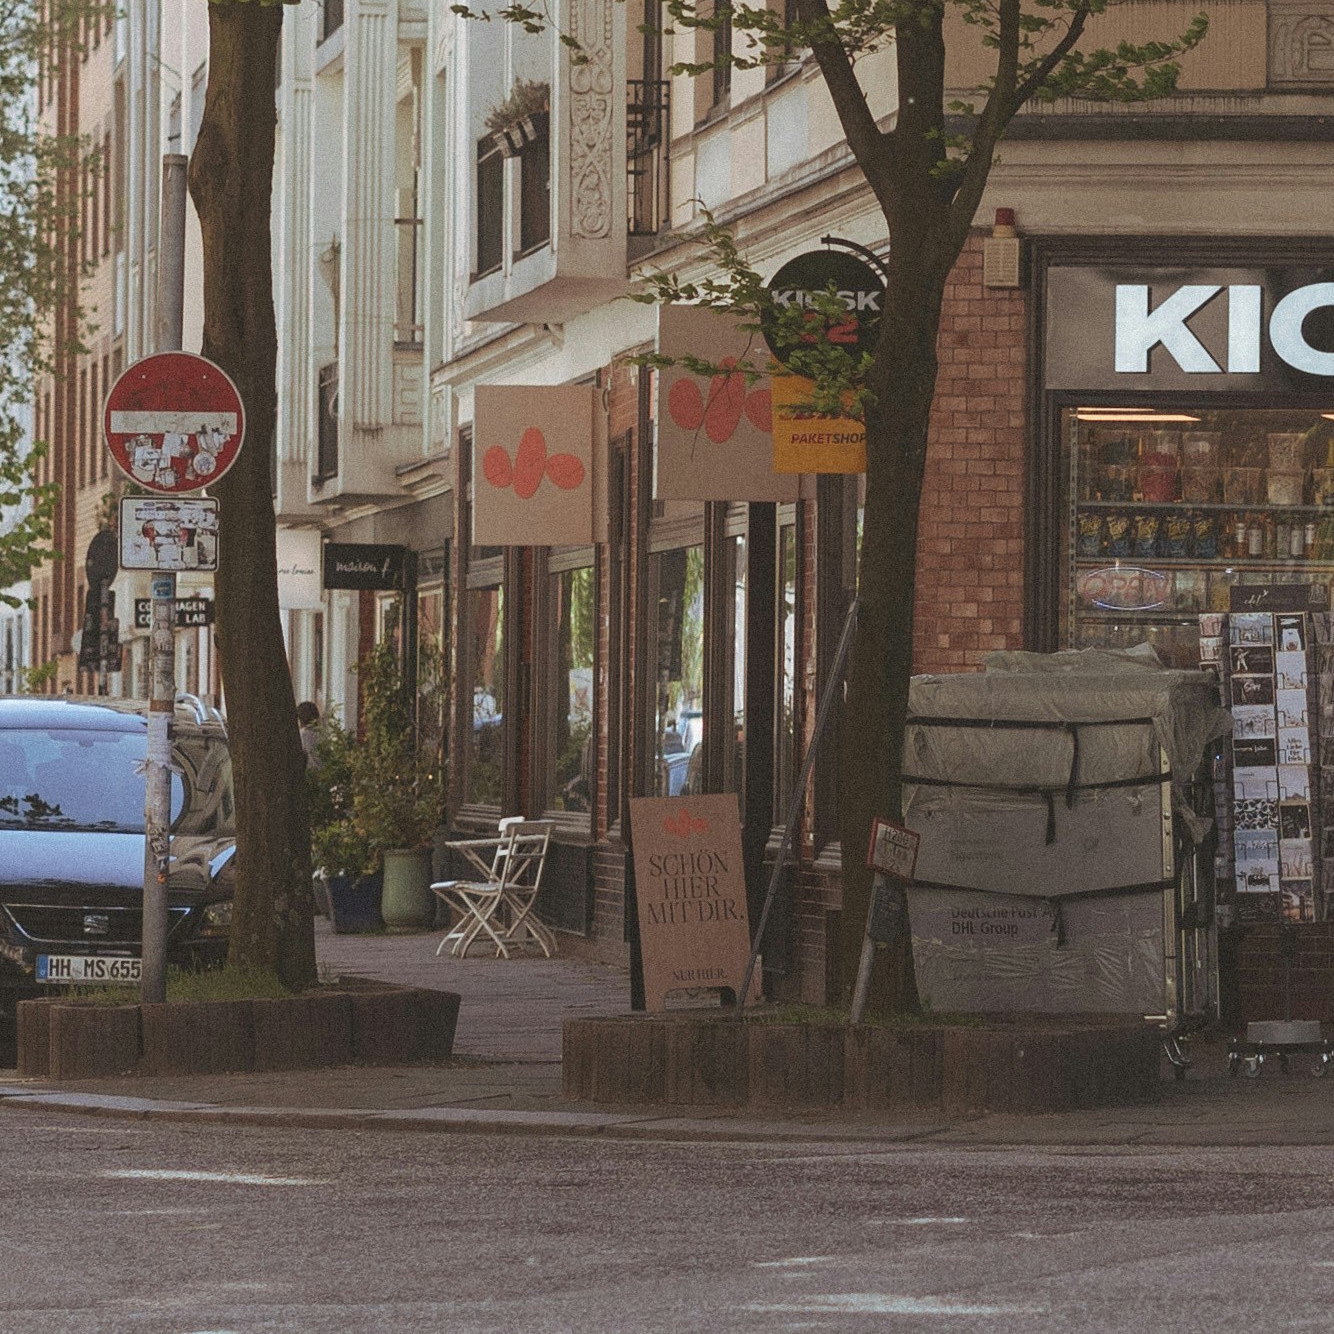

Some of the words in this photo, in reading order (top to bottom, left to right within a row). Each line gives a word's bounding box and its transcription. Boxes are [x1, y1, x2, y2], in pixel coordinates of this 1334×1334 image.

[185, 613, 206, 624] LAB
[649, 849, 729, 878] SCHÖN
[662, 876, 721, 900] HIER
[647, 900, 693, 925] MIT
[699, 898, 745, 922] DIR.
[951, 921, 975, 935] DHL
[979, 921, 1019, 937] Group
[48, 958, 71, 977] HH
[83, 959, 106, 978] MS
[110, 960, 141, 979] 655
